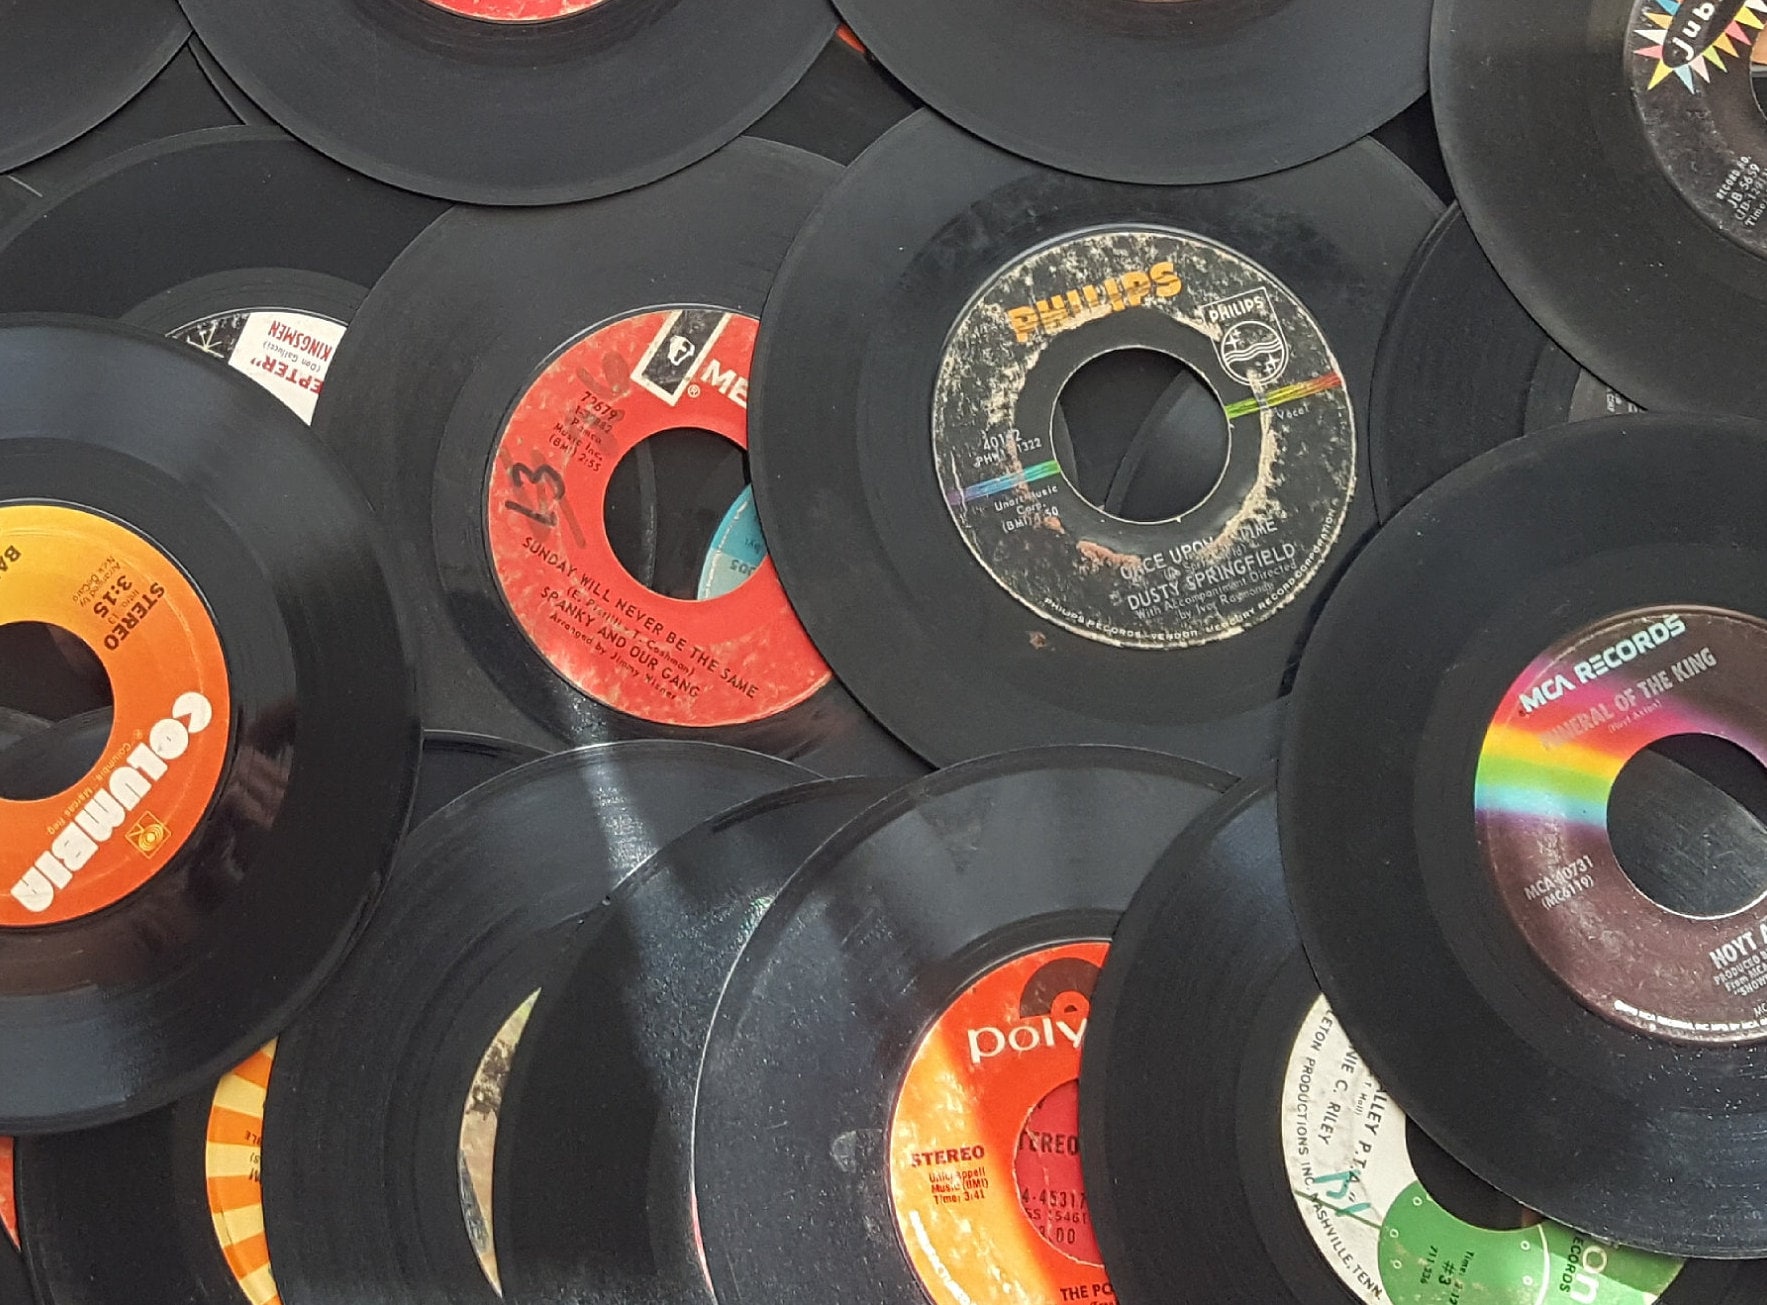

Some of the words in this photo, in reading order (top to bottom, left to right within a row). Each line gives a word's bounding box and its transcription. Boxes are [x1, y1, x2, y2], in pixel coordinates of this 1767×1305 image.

[1727, 192, 1743, 208] JB
[1006, 261, 1183, 343] PHILIPS
[1209, 296, 1264, 323] PHILIPS
[267, 320, 332, 362] KINGSMEN
[983, 429, 1022, 450] 4012
[1127, 581, 1180, 610] DUSTY
[1186, 543, 1295, 591] SPRINGFIELD
[1136, 605, 1162, 620] With
[1165, 579, 1247, 612] Accompaniment
[1249, 558, 1298, 583] Directed
[1258, 577, 1296, 610] RECORD
[93, 575, 133, 618] 3:15
[103, 582, 165, 650] STEREO
[522, 537, 578, 577] SUNDAY
[580, 573, 610, 602] WILL
[615, 598, 664, 635] NEVER
[666, 631, 688, 652] BE
[689, 647, 719, 673] THE
[720, 668, 759, 698] SAME
[541, 586, 596, 627] SPANKY
[597, 626, 627, 648] AND
[629, 645, 658, 670] OUR
[661, 667, 700, 698] GANG
[549, 612, 593, 644] Arranged
[594, 641, 606, 655] by
[610, 653, 640, 677] Jimmy
[1518, 674, 1576, 713] MCA
[1573, 614, 1687, 684] RECORDS
[1614, 688, 1638, 712] OF
[1637, 669, 1674, 699] THE
[1671, 646, 1718, 682] KING
[10, 691, 213, 912] COLUMBIA
[1541, 874, 1594, 911] (MC6119)
[1709, 931, 1757, 970] HOYT
[1713, 956, 1761, 986] PRODUCED
[1725, 976, 1750, 992] From
[1333, 1079, 1349, 1093] C.
[1296, 1056, 1316, 1156] PRODUCTIONS
[1318, 1101, 1341, 1146] RILEY
[911, 1145, 985, 1168] STEREO
[964, 1189, 985, 1202] 3:41
[1301, 1161, 1316, 1192] INC.
[1352, 1263, 1383, 1301] TENN.
[1438, 1260, 1456, 1285] #3
[1060, 1285, 1089, 1301] THE
